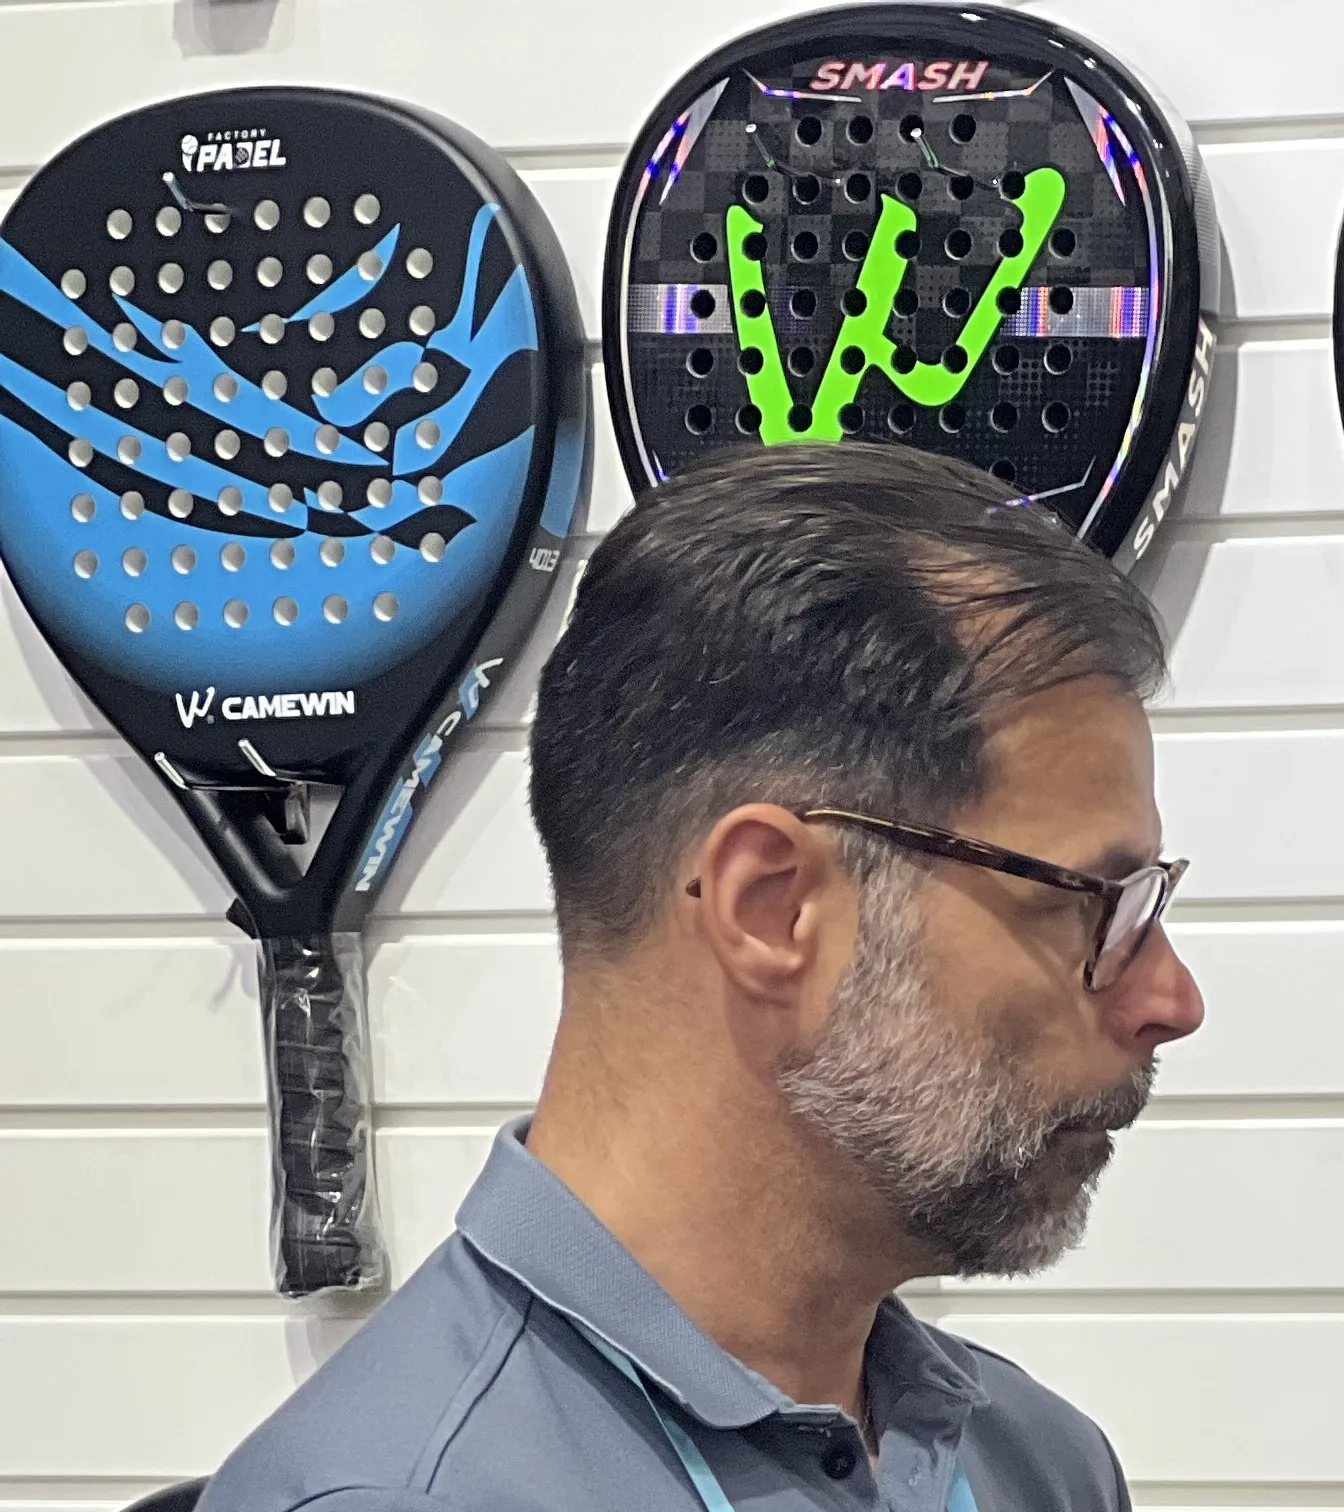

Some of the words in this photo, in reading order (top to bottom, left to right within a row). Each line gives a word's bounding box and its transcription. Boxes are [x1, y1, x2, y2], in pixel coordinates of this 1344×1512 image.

[811, 61, 989, 91] SMASH
[208, 128, 267, 141] FACTORY
[1133, 314, 1216, 560] SMASH
[221, 690, 356, 721] CAMEWIN
